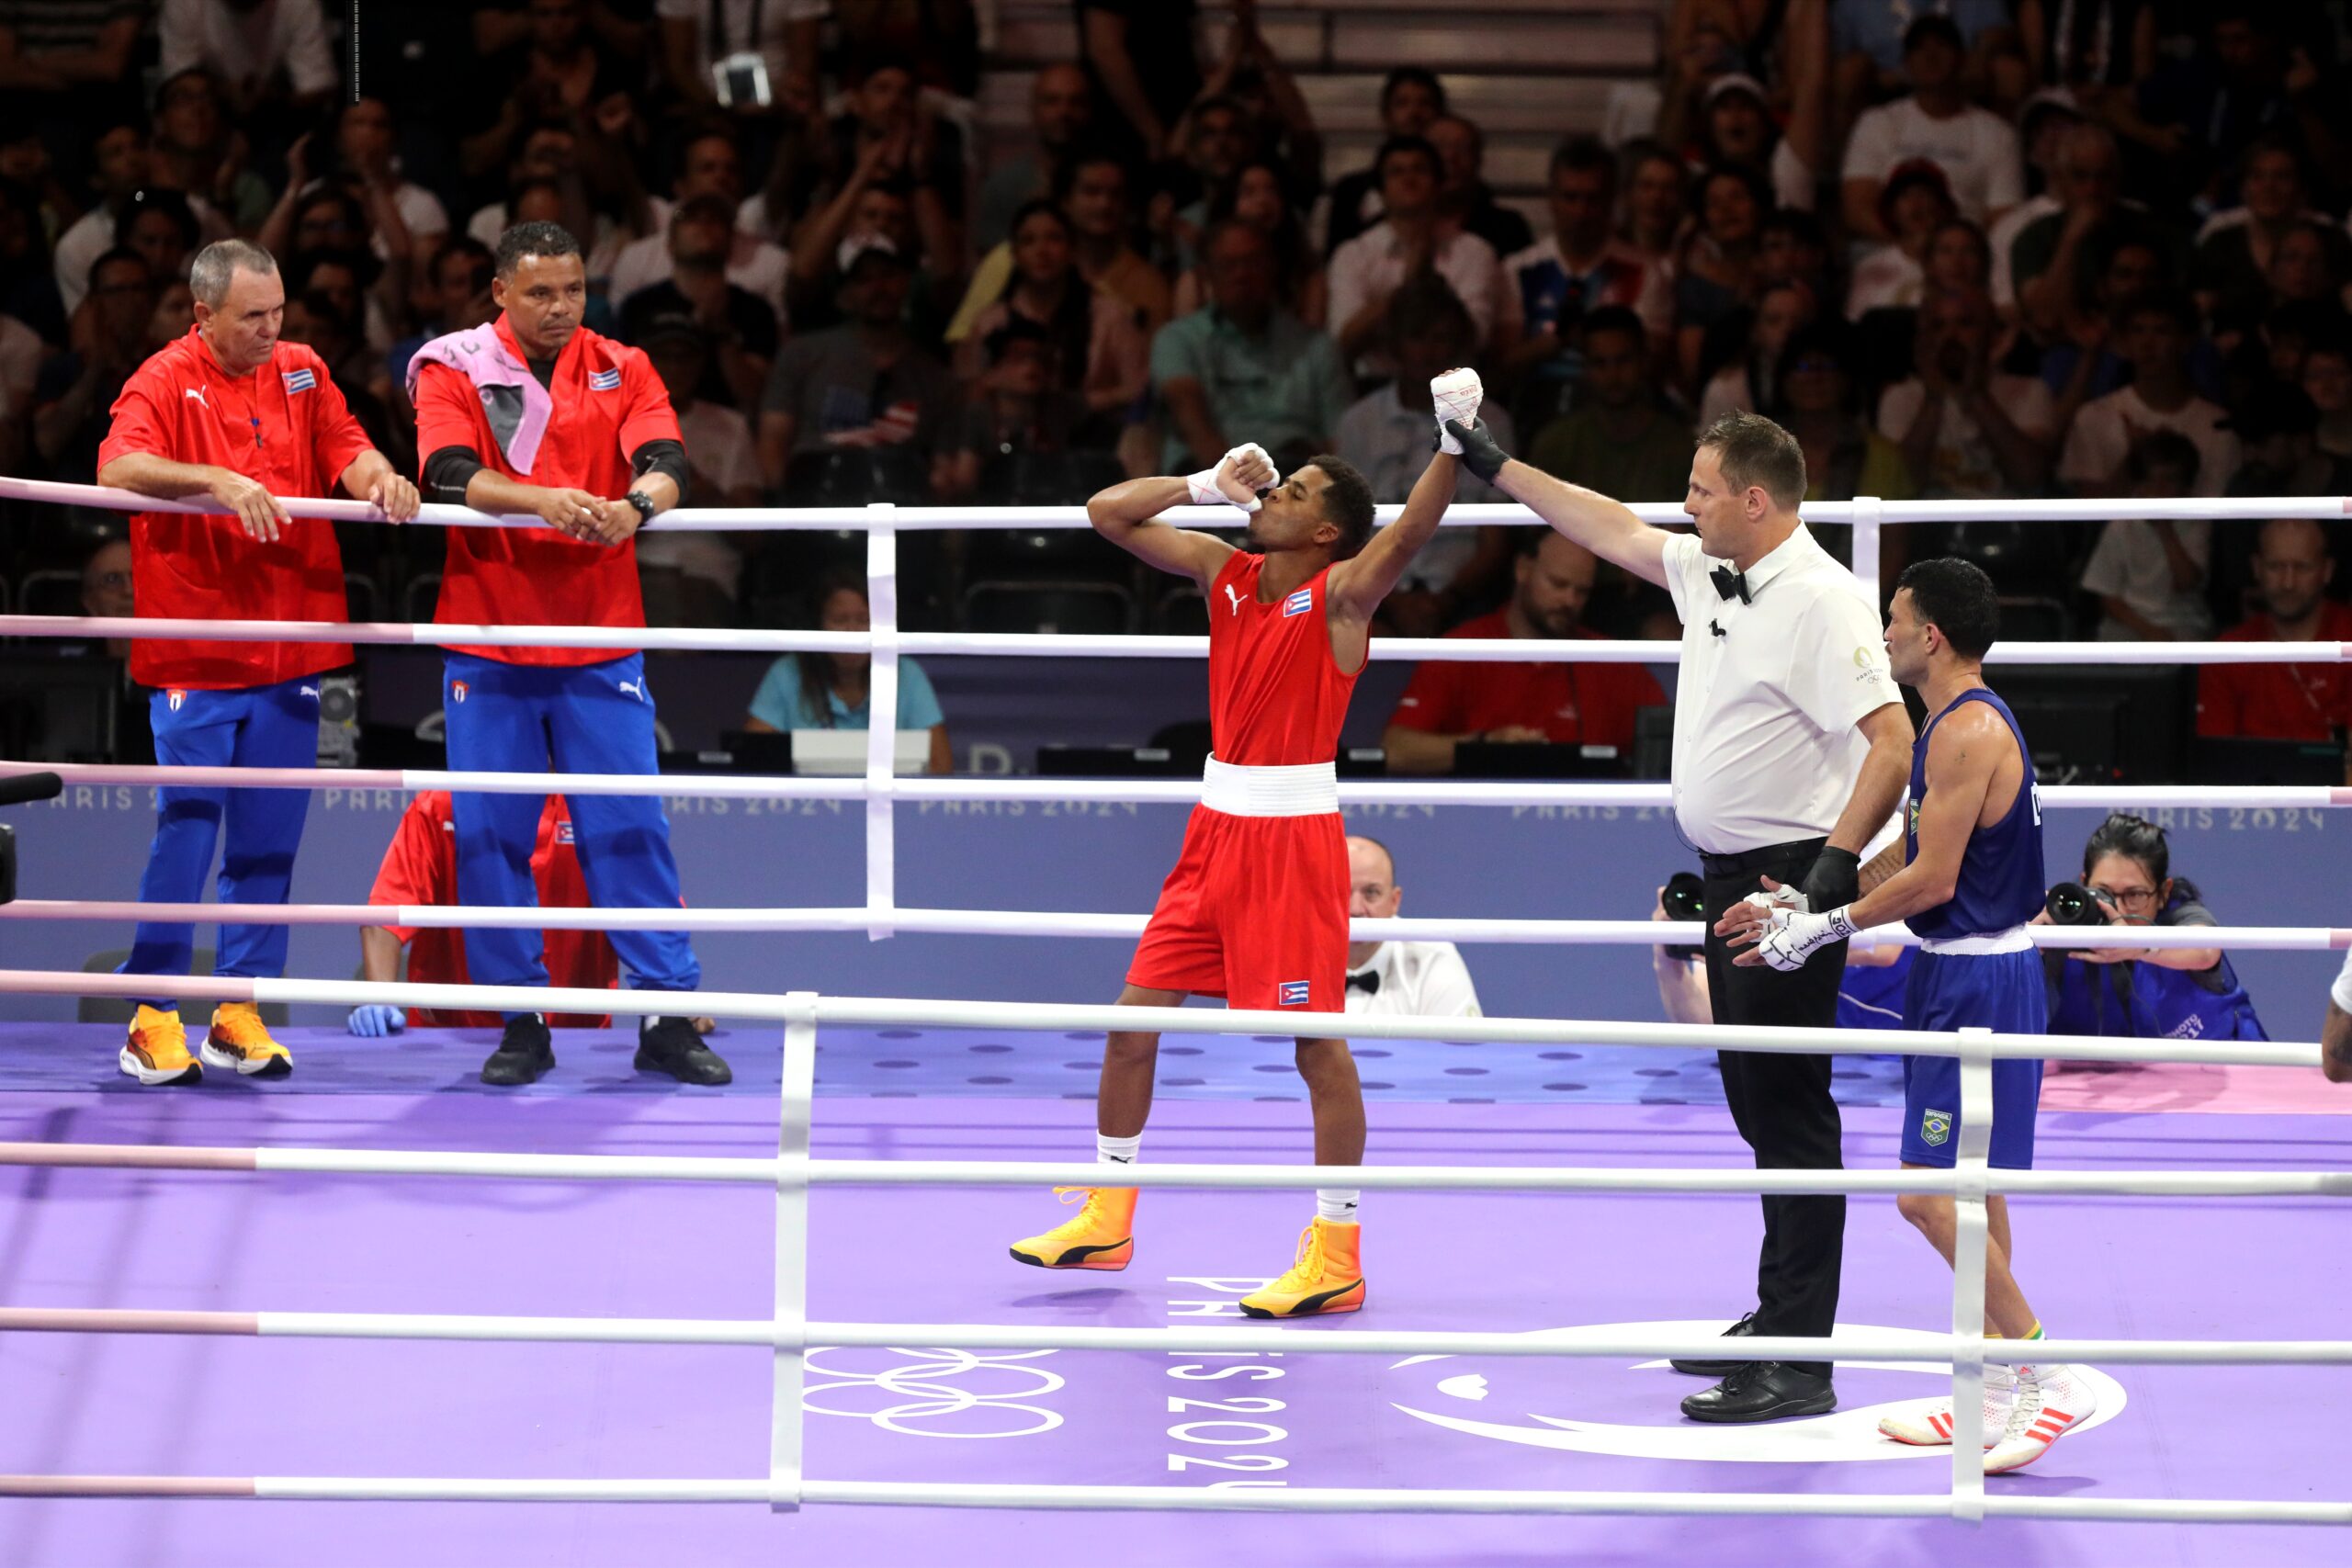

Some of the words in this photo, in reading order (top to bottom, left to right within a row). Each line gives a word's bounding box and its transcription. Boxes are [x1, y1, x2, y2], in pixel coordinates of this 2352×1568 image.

[26, 786, 132, 809] ARIS
[324, 788, 409, 810] PARI
[2229, 807, 2324, 831] 2024
